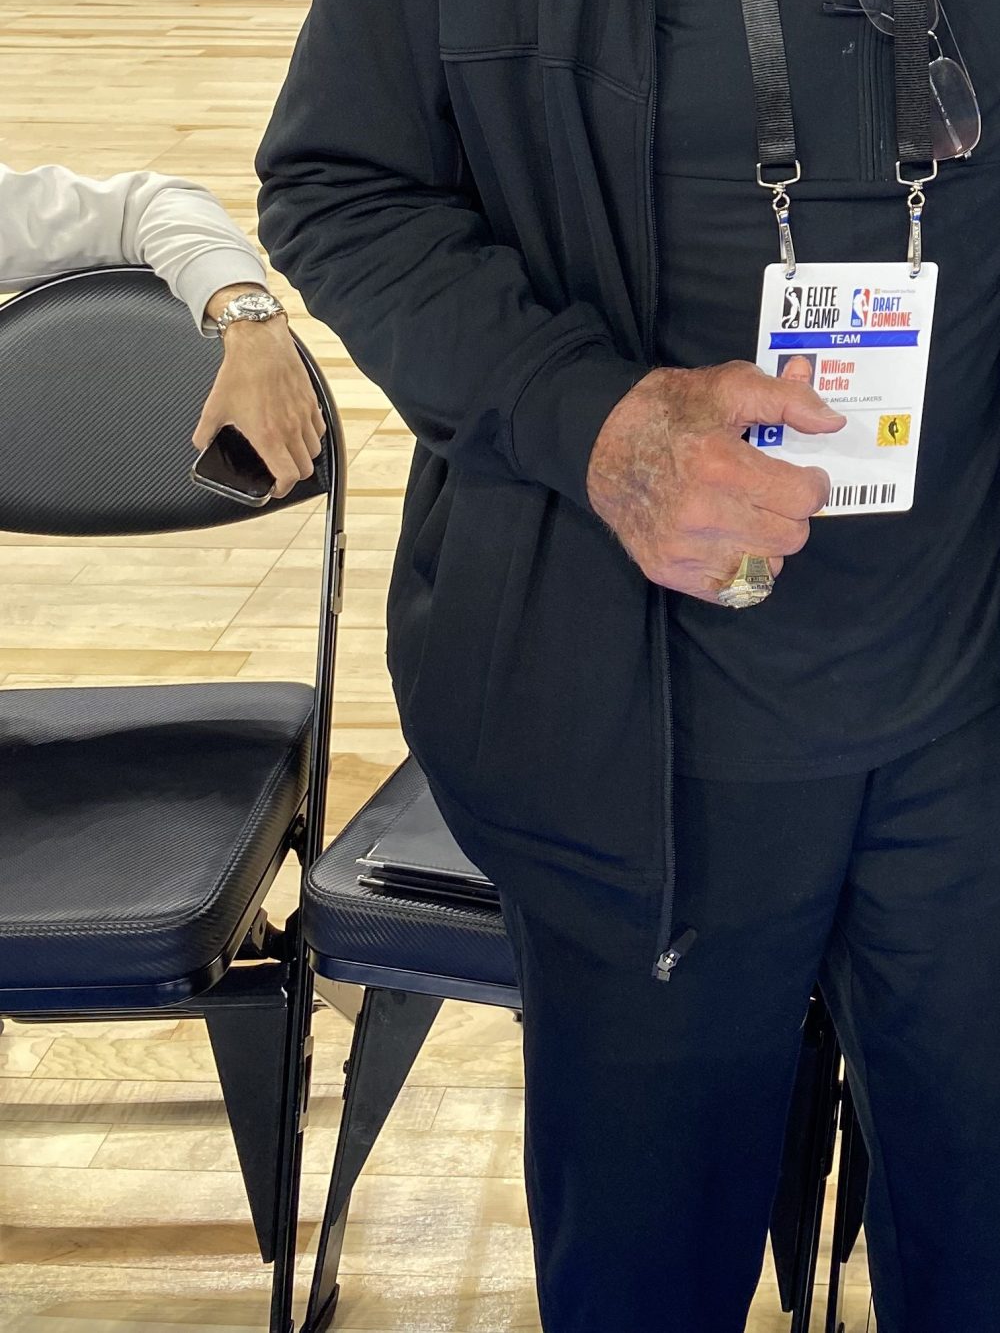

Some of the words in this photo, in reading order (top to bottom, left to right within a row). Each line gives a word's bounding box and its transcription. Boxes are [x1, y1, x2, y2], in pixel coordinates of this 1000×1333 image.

[806, 286, 838, 307] ELITE
[872, 297, 901, 312] DRAFT
[804, 308, 840, 329] CAMP
[871, 312, 912, 328] COMBINE
[830, 334, 860, 344] TEAM
[820, 360, 855, 374] William
[819, 377, 849, 391] Bertka
[830, 396, 858, 404] ANGELES
[859, 395, 883, 403] LAKERS
[764, 427, 778, 443] C
